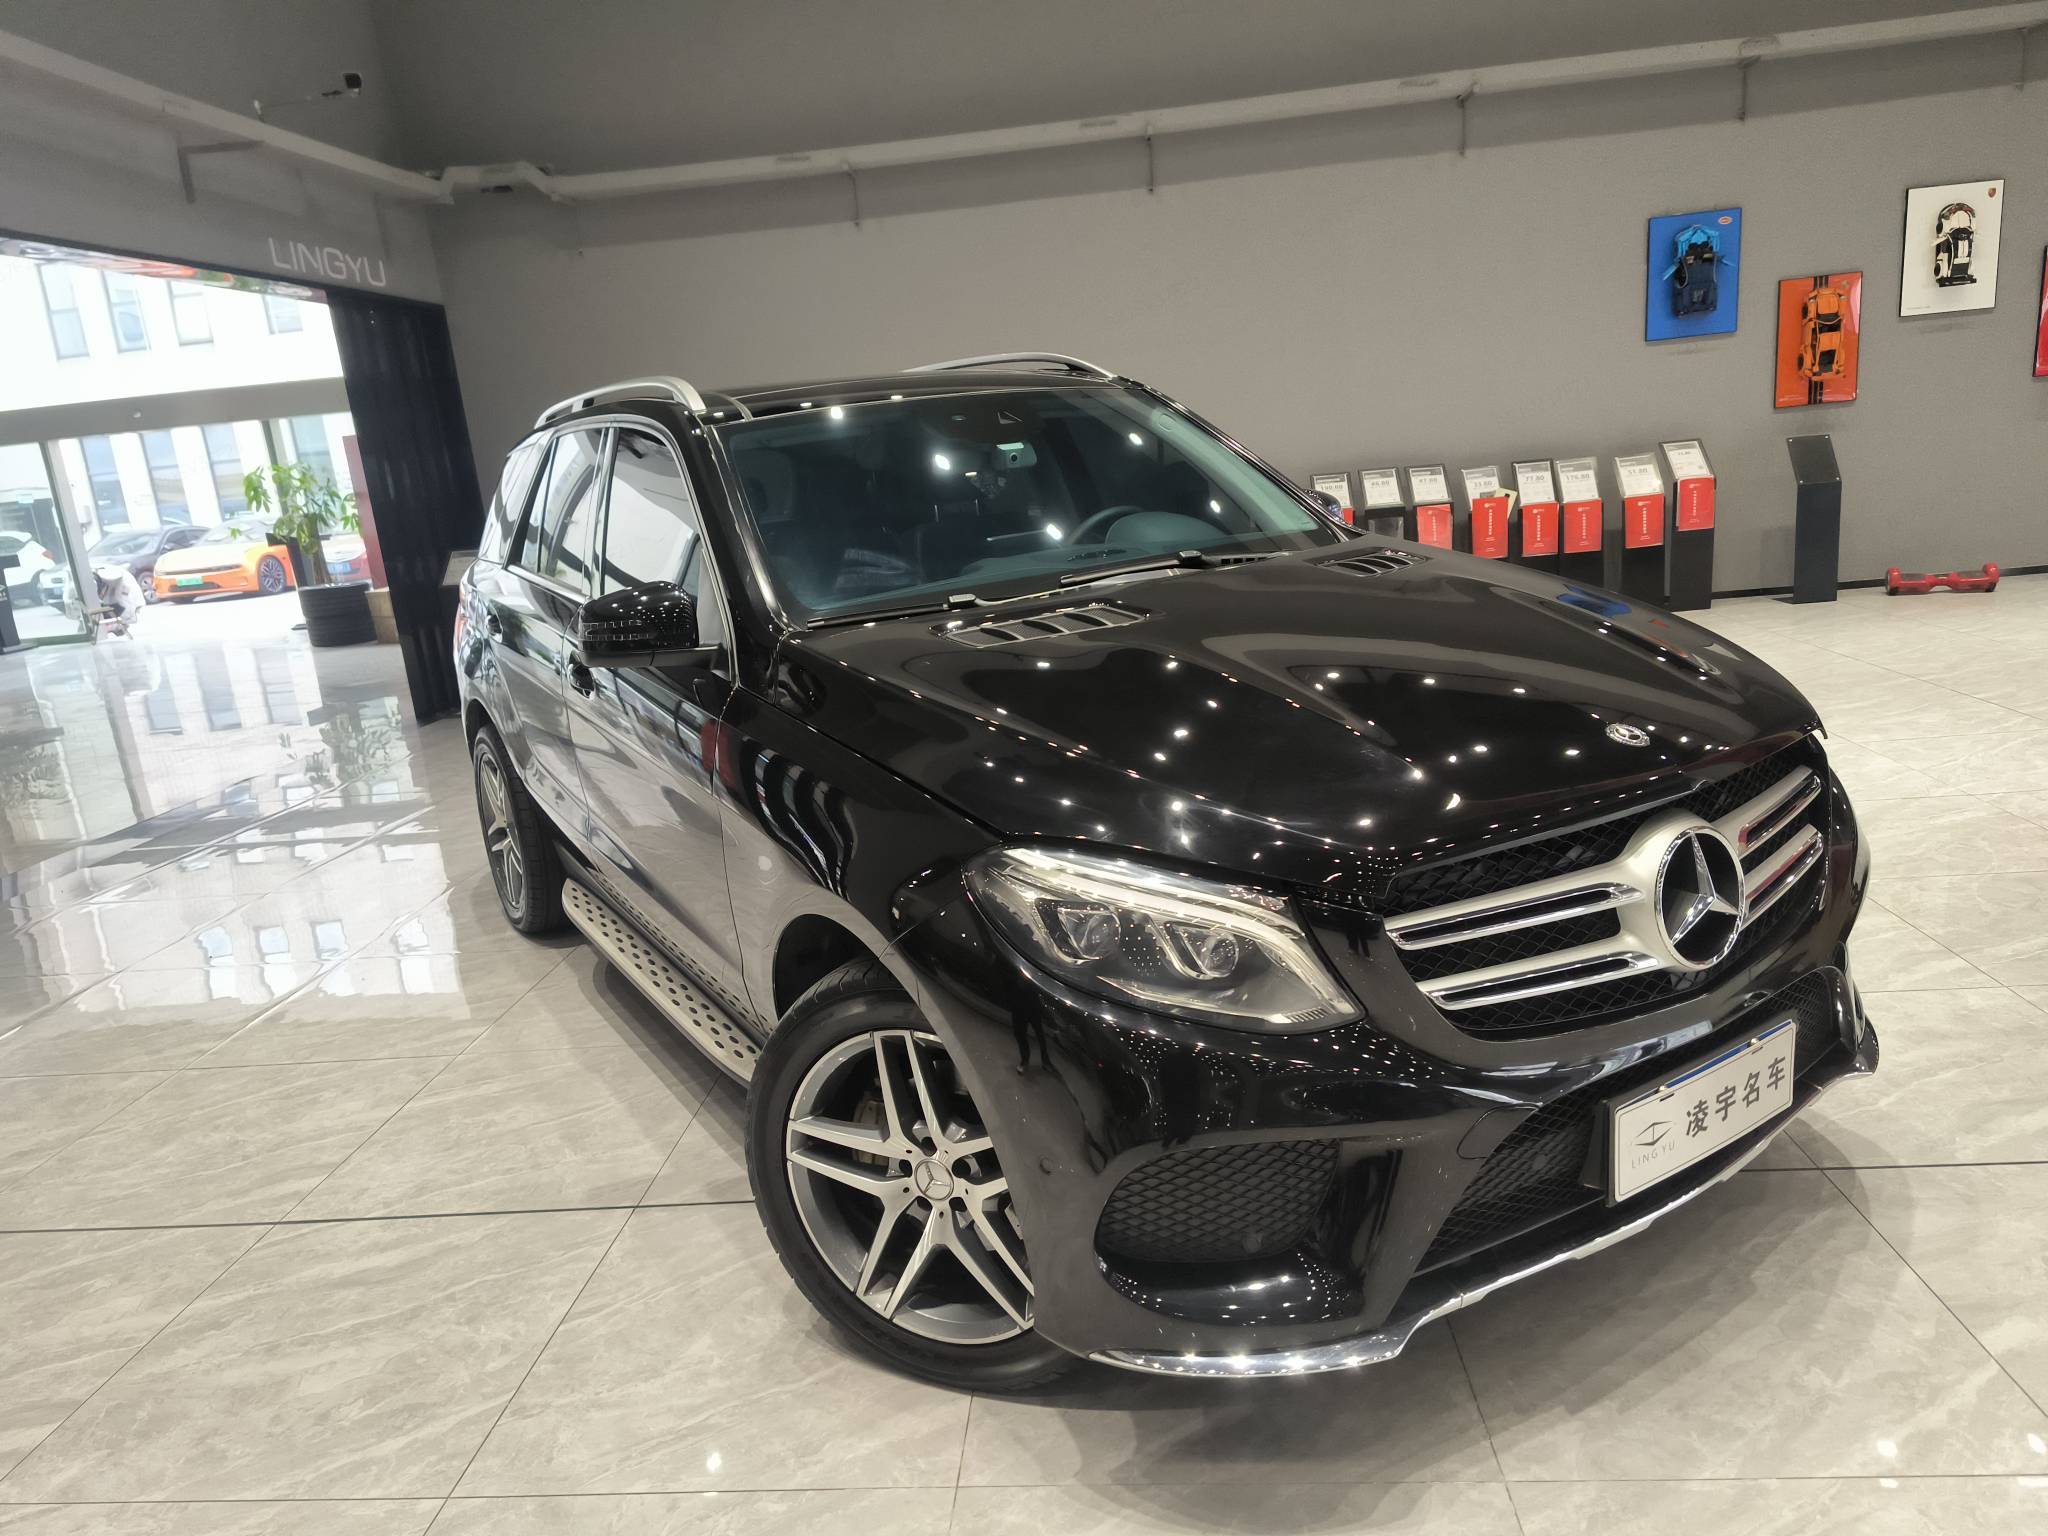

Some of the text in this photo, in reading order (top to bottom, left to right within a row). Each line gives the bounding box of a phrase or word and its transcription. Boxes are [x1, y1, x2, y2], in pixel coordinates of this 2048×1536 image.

[268, 237, 387, 287] LINGYU
[1685, 1055, 1786, 1139] 凌宇名车
